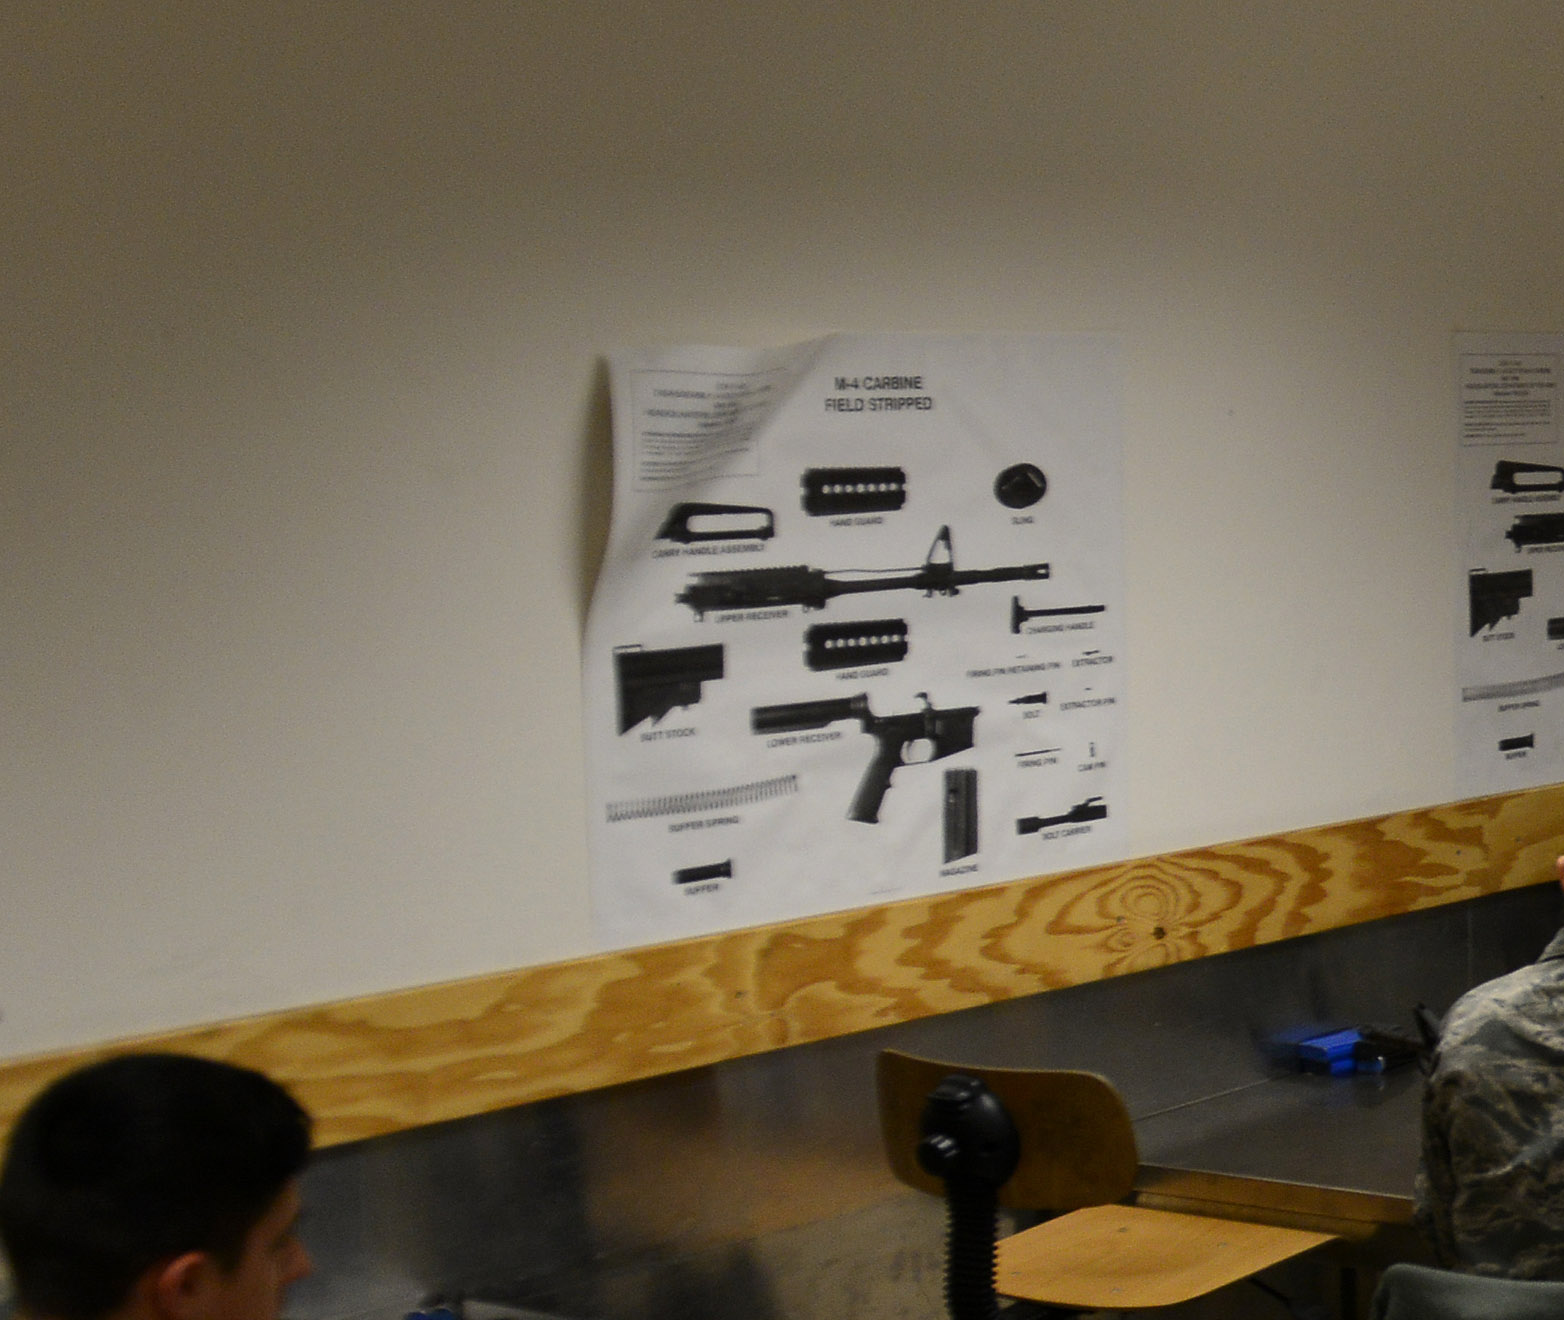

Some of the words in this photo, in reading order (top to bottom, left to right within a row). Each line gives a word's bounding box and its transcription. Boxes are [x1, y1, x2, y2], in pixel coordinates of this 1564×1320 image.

[834, 377, 859, 391] M-4
[863, 376, 923, 391] CARBINE
[824, 398, 865, 412] FIELD
[868, 397, 932, 412] STRIPPED
